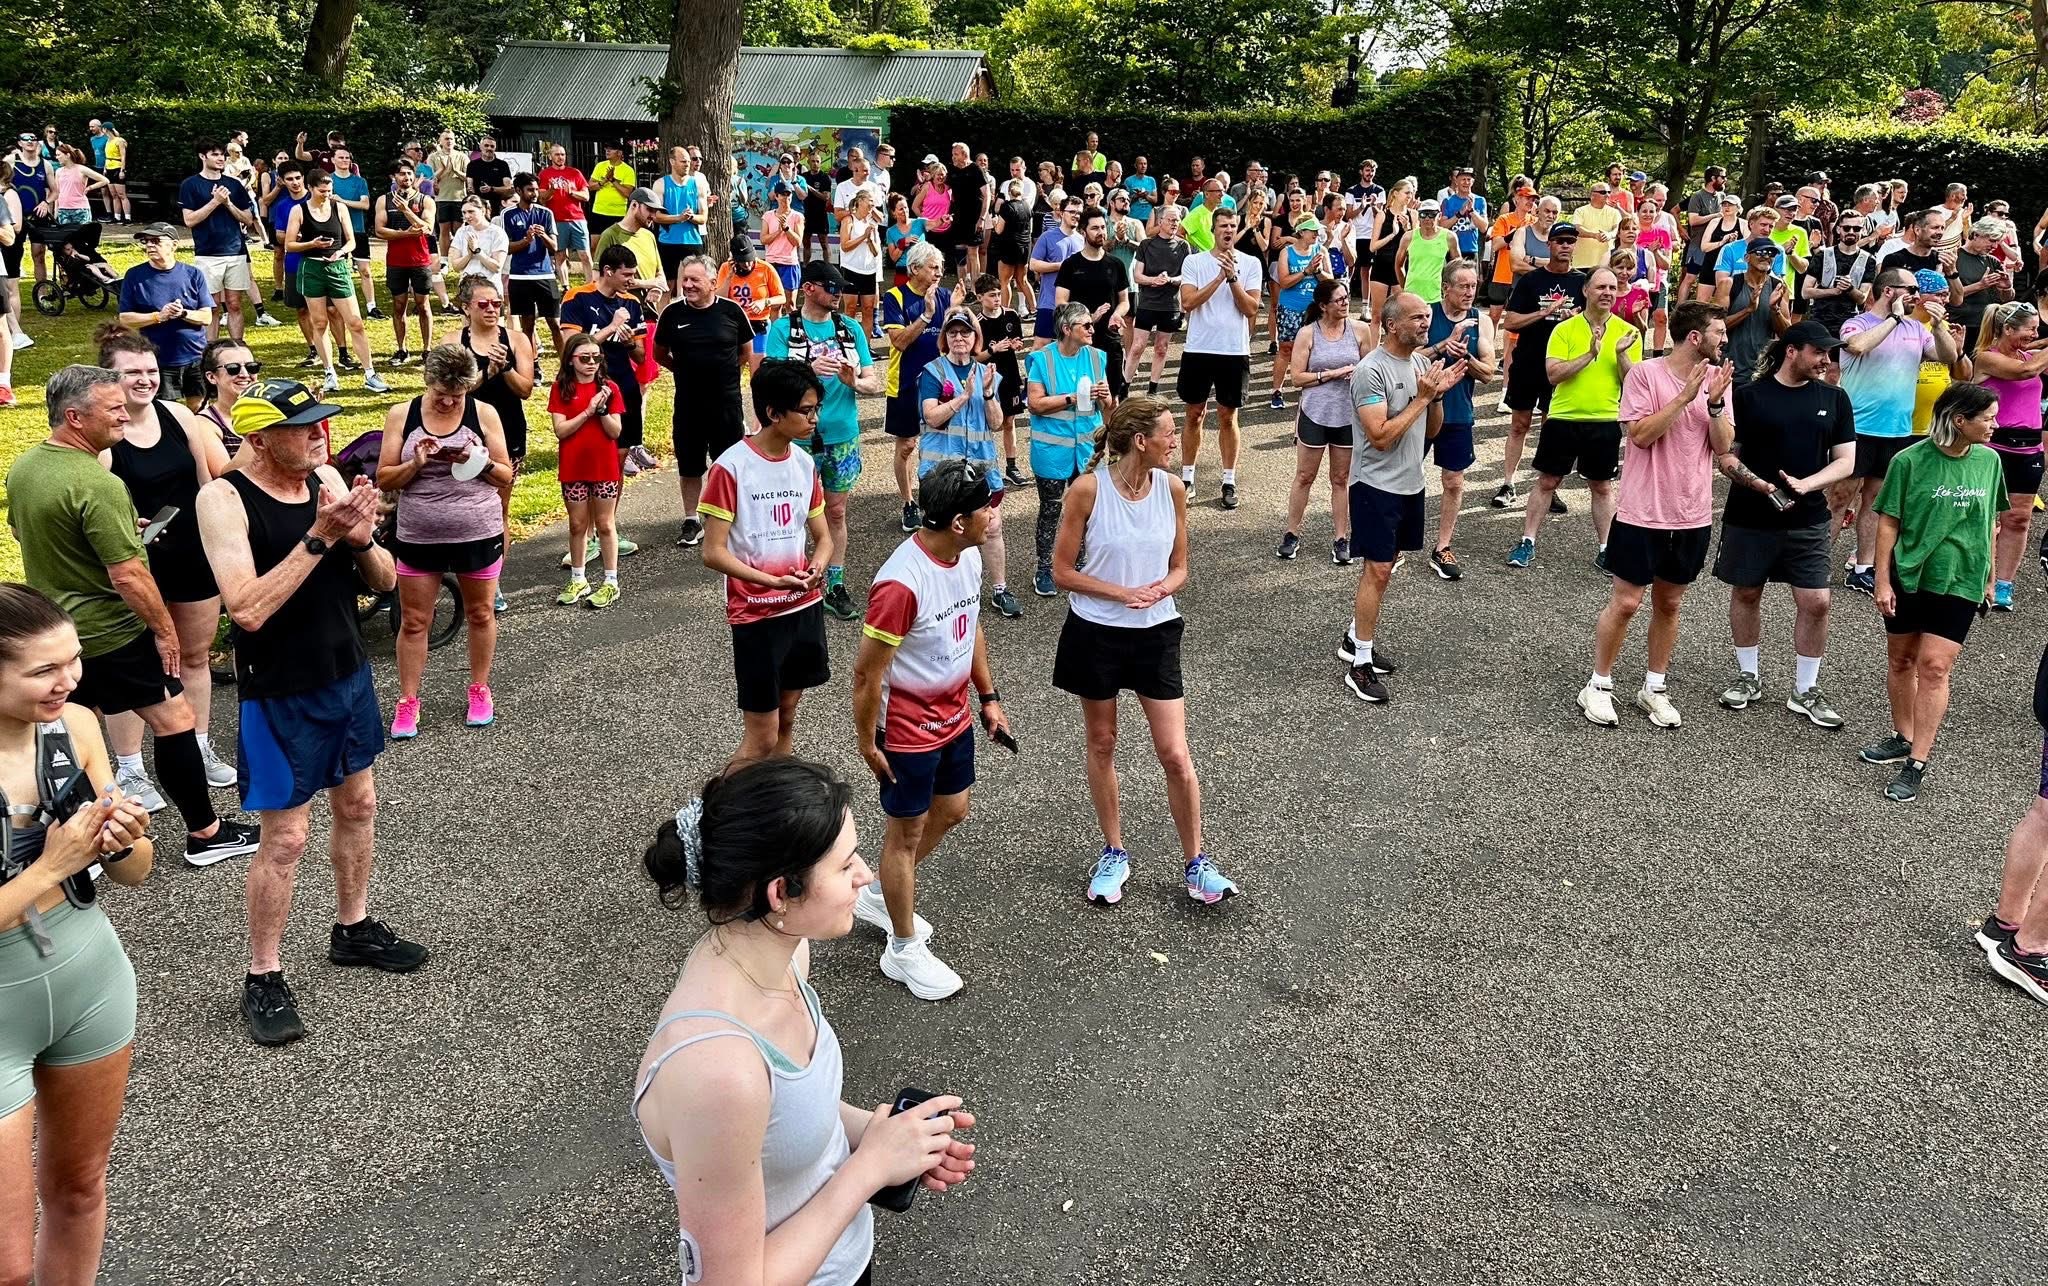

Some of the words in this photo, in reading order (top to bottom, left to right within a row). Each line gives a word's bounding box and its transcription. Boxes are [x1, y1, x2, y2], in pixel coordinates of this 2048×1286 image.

[733, 285, 751, 297] 20
[751, 492, 775, 501] WACE
[777, 490, 803, 498] MORA
[751, 529, 797, 539] SHEWSBU
[954, 594, 980, 610] MORGA
